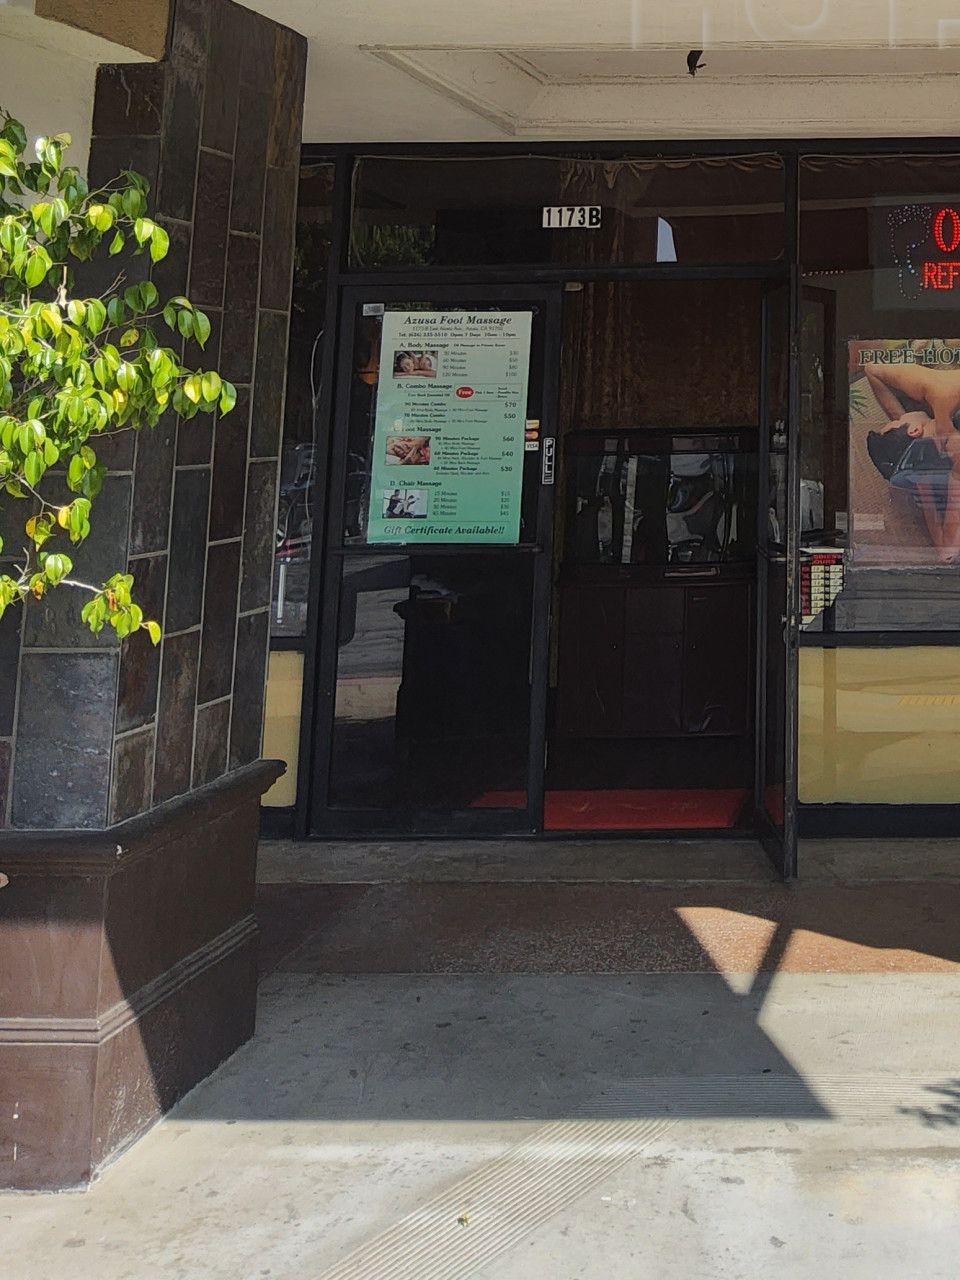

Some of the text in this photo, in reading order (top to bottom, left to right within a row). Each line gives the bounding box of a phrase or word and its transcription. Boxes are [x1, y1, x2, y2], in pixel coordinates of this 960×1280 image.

[546, 207, 601, 227] 1173B
[404, 316, 512, 325] Azusa Foot Massage
[859, 349, 916, 365] FREE
[545, 440, 553, 473] PULL
[384, 525, 505, 535] Gift Certificate Available!!
